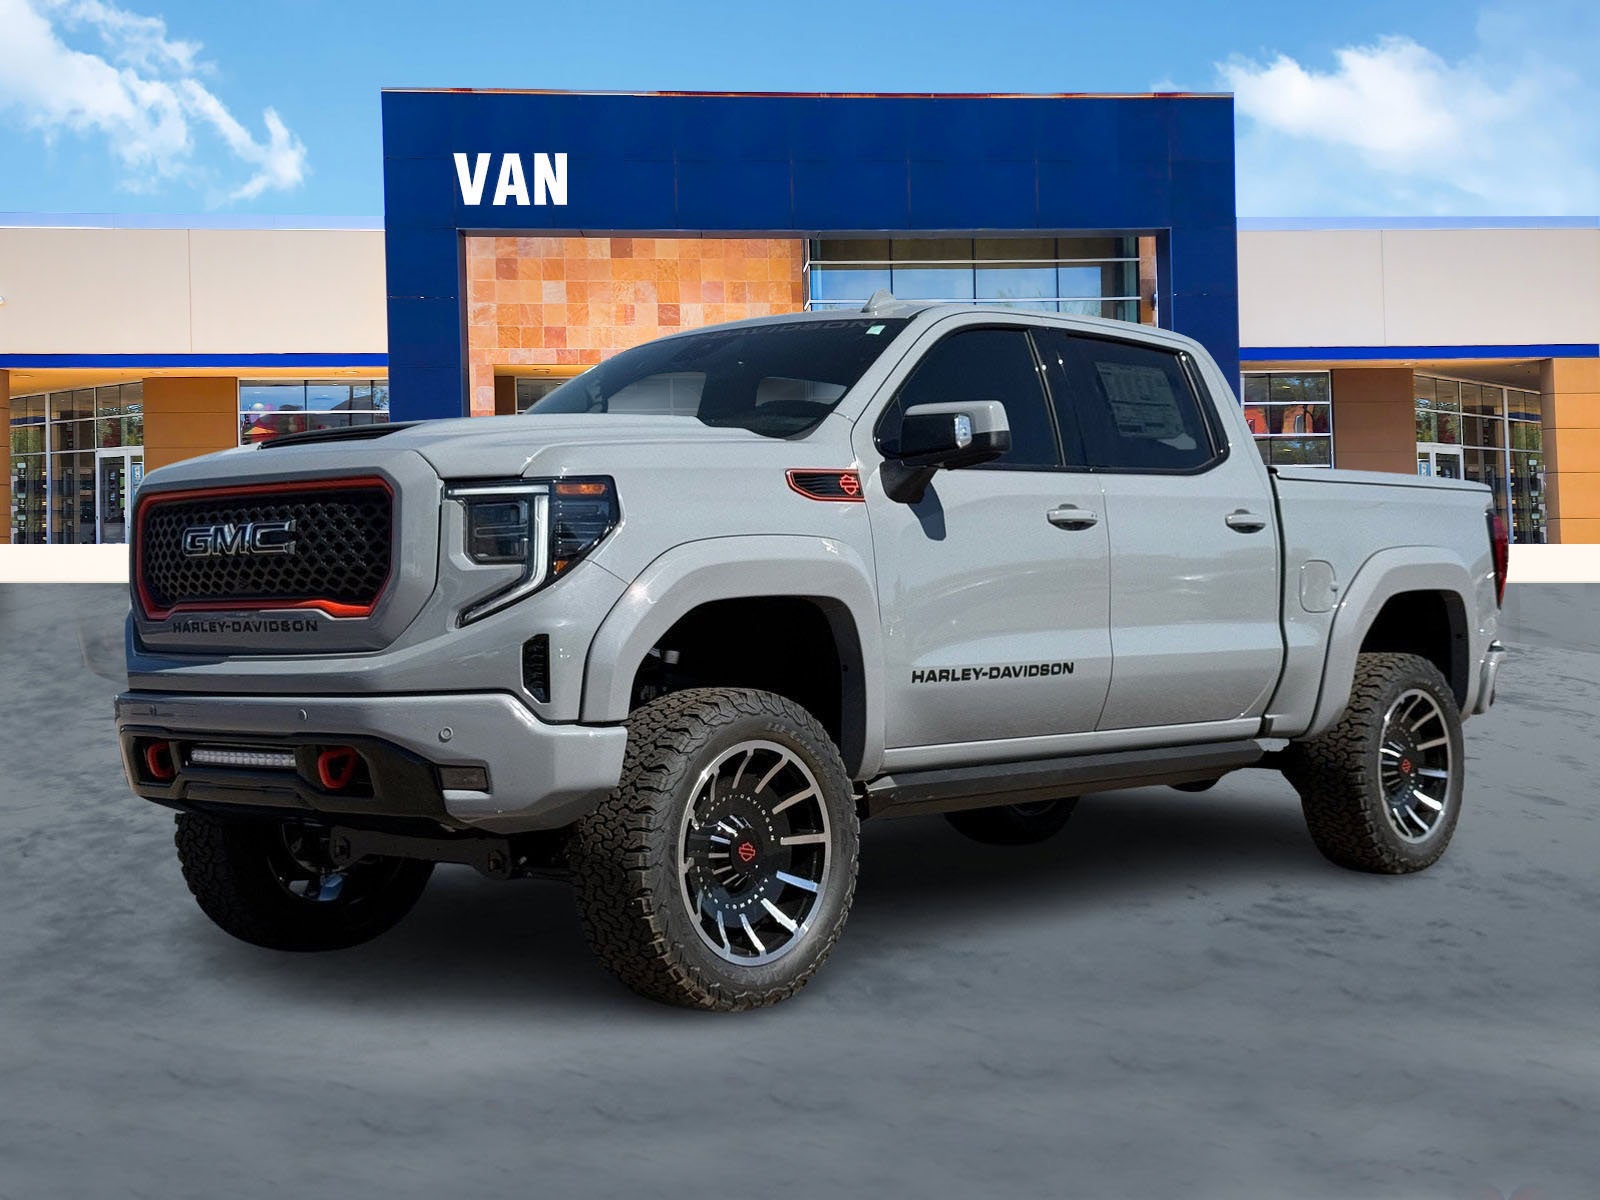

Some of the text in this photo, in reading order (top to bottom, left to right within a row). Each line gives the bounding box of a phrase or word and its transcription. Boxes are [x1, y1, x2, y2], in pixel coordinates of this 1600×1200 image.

[453, 152, 568, 206] VAN
[182, 519, 297, 557] GMC
[172, 620, 319, 634] HARLEY-DAVIDSON
[911, 662, 1075, 684] HARLEY-DAVIDSON
